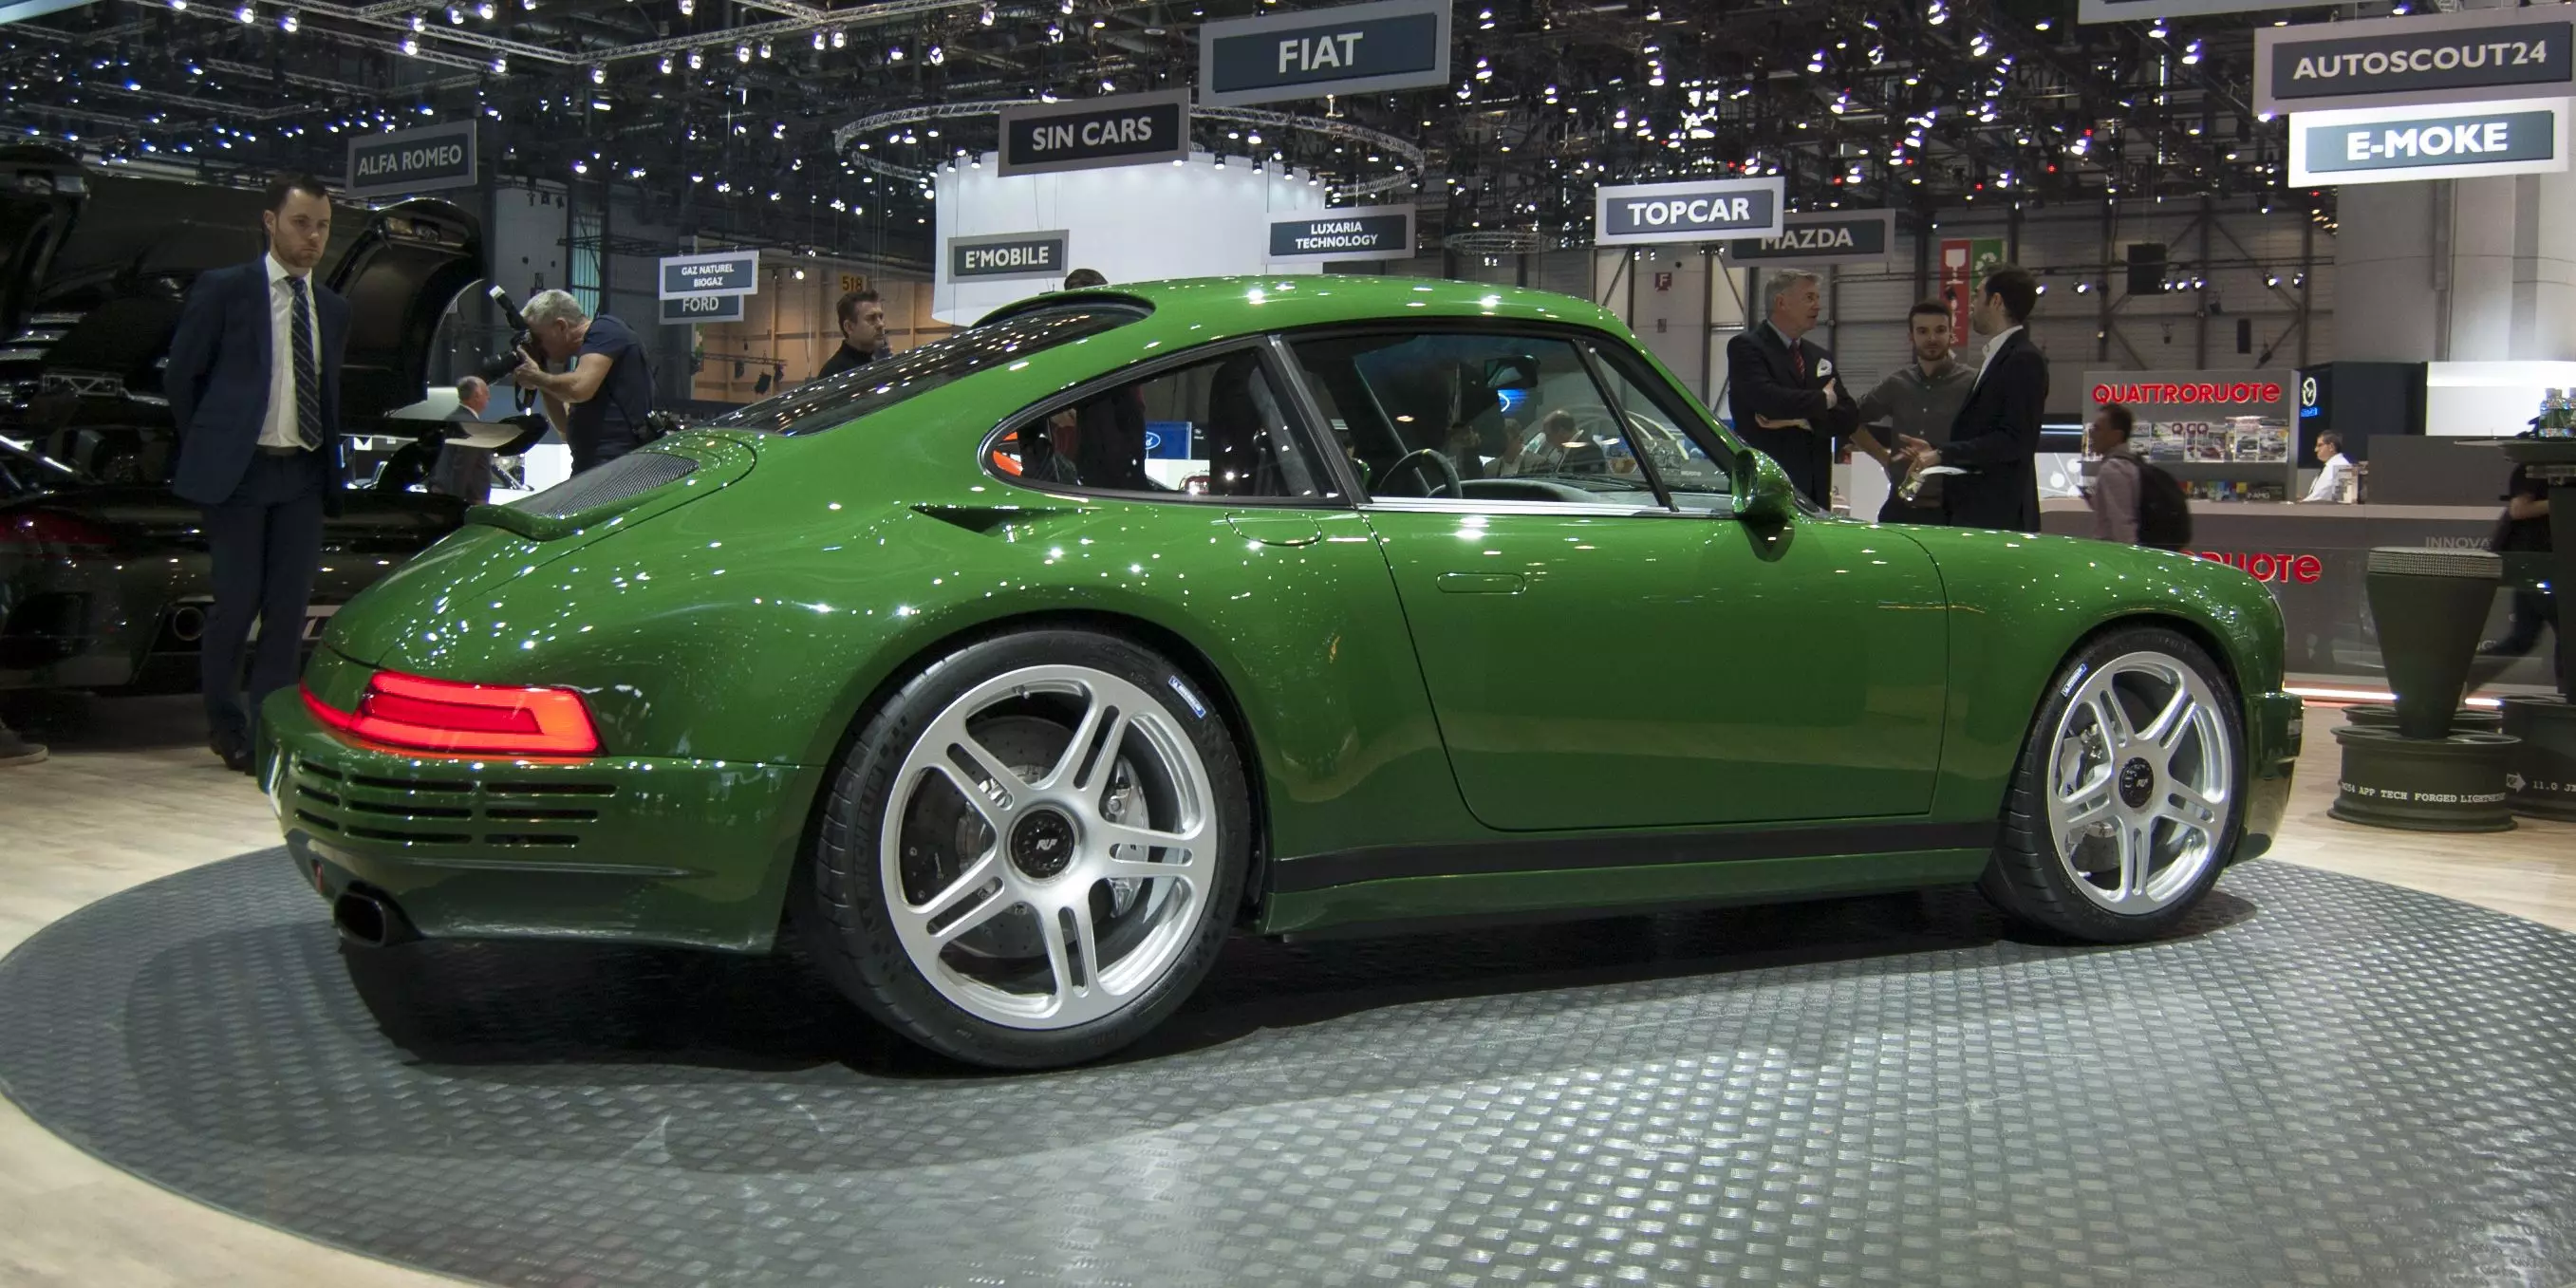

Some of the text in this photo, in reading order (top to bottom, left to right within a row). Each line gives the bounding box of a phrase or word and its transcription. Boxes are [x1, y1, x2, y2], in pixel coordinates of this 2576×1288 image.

[1279, 31, 1364, 73] FIAT
[2292, 40, 2548, 80] AUTOSCOUT24
[1032, 117, 1152, 151] SIN CARS
[2346, 122, 2509, 160] E-MOKE
[357, 144, 462, 176] ALFA ROMEO
[1627, 197, 1750, 227] TOPCAR
[1310, 221, 1363, 235] LUXARIA
[1295, 233, 1378, 250] TECHNOLOGY
[1760, 228, 1854, 252] MAZDA
[681, 263, 735, 276] GAZ NATUREL
[693, 276, 724, 288] BIOGAZ
[842, 275, 864, 291] 518
[681, 297, 719, 312] FORD
[2532, 780, 2559, 791] 11.0
[2359, 786, 2376, 796] APP
[2380, 789, 2409, 801] TECH
[2415, 793, 2457, 803] FORGED
